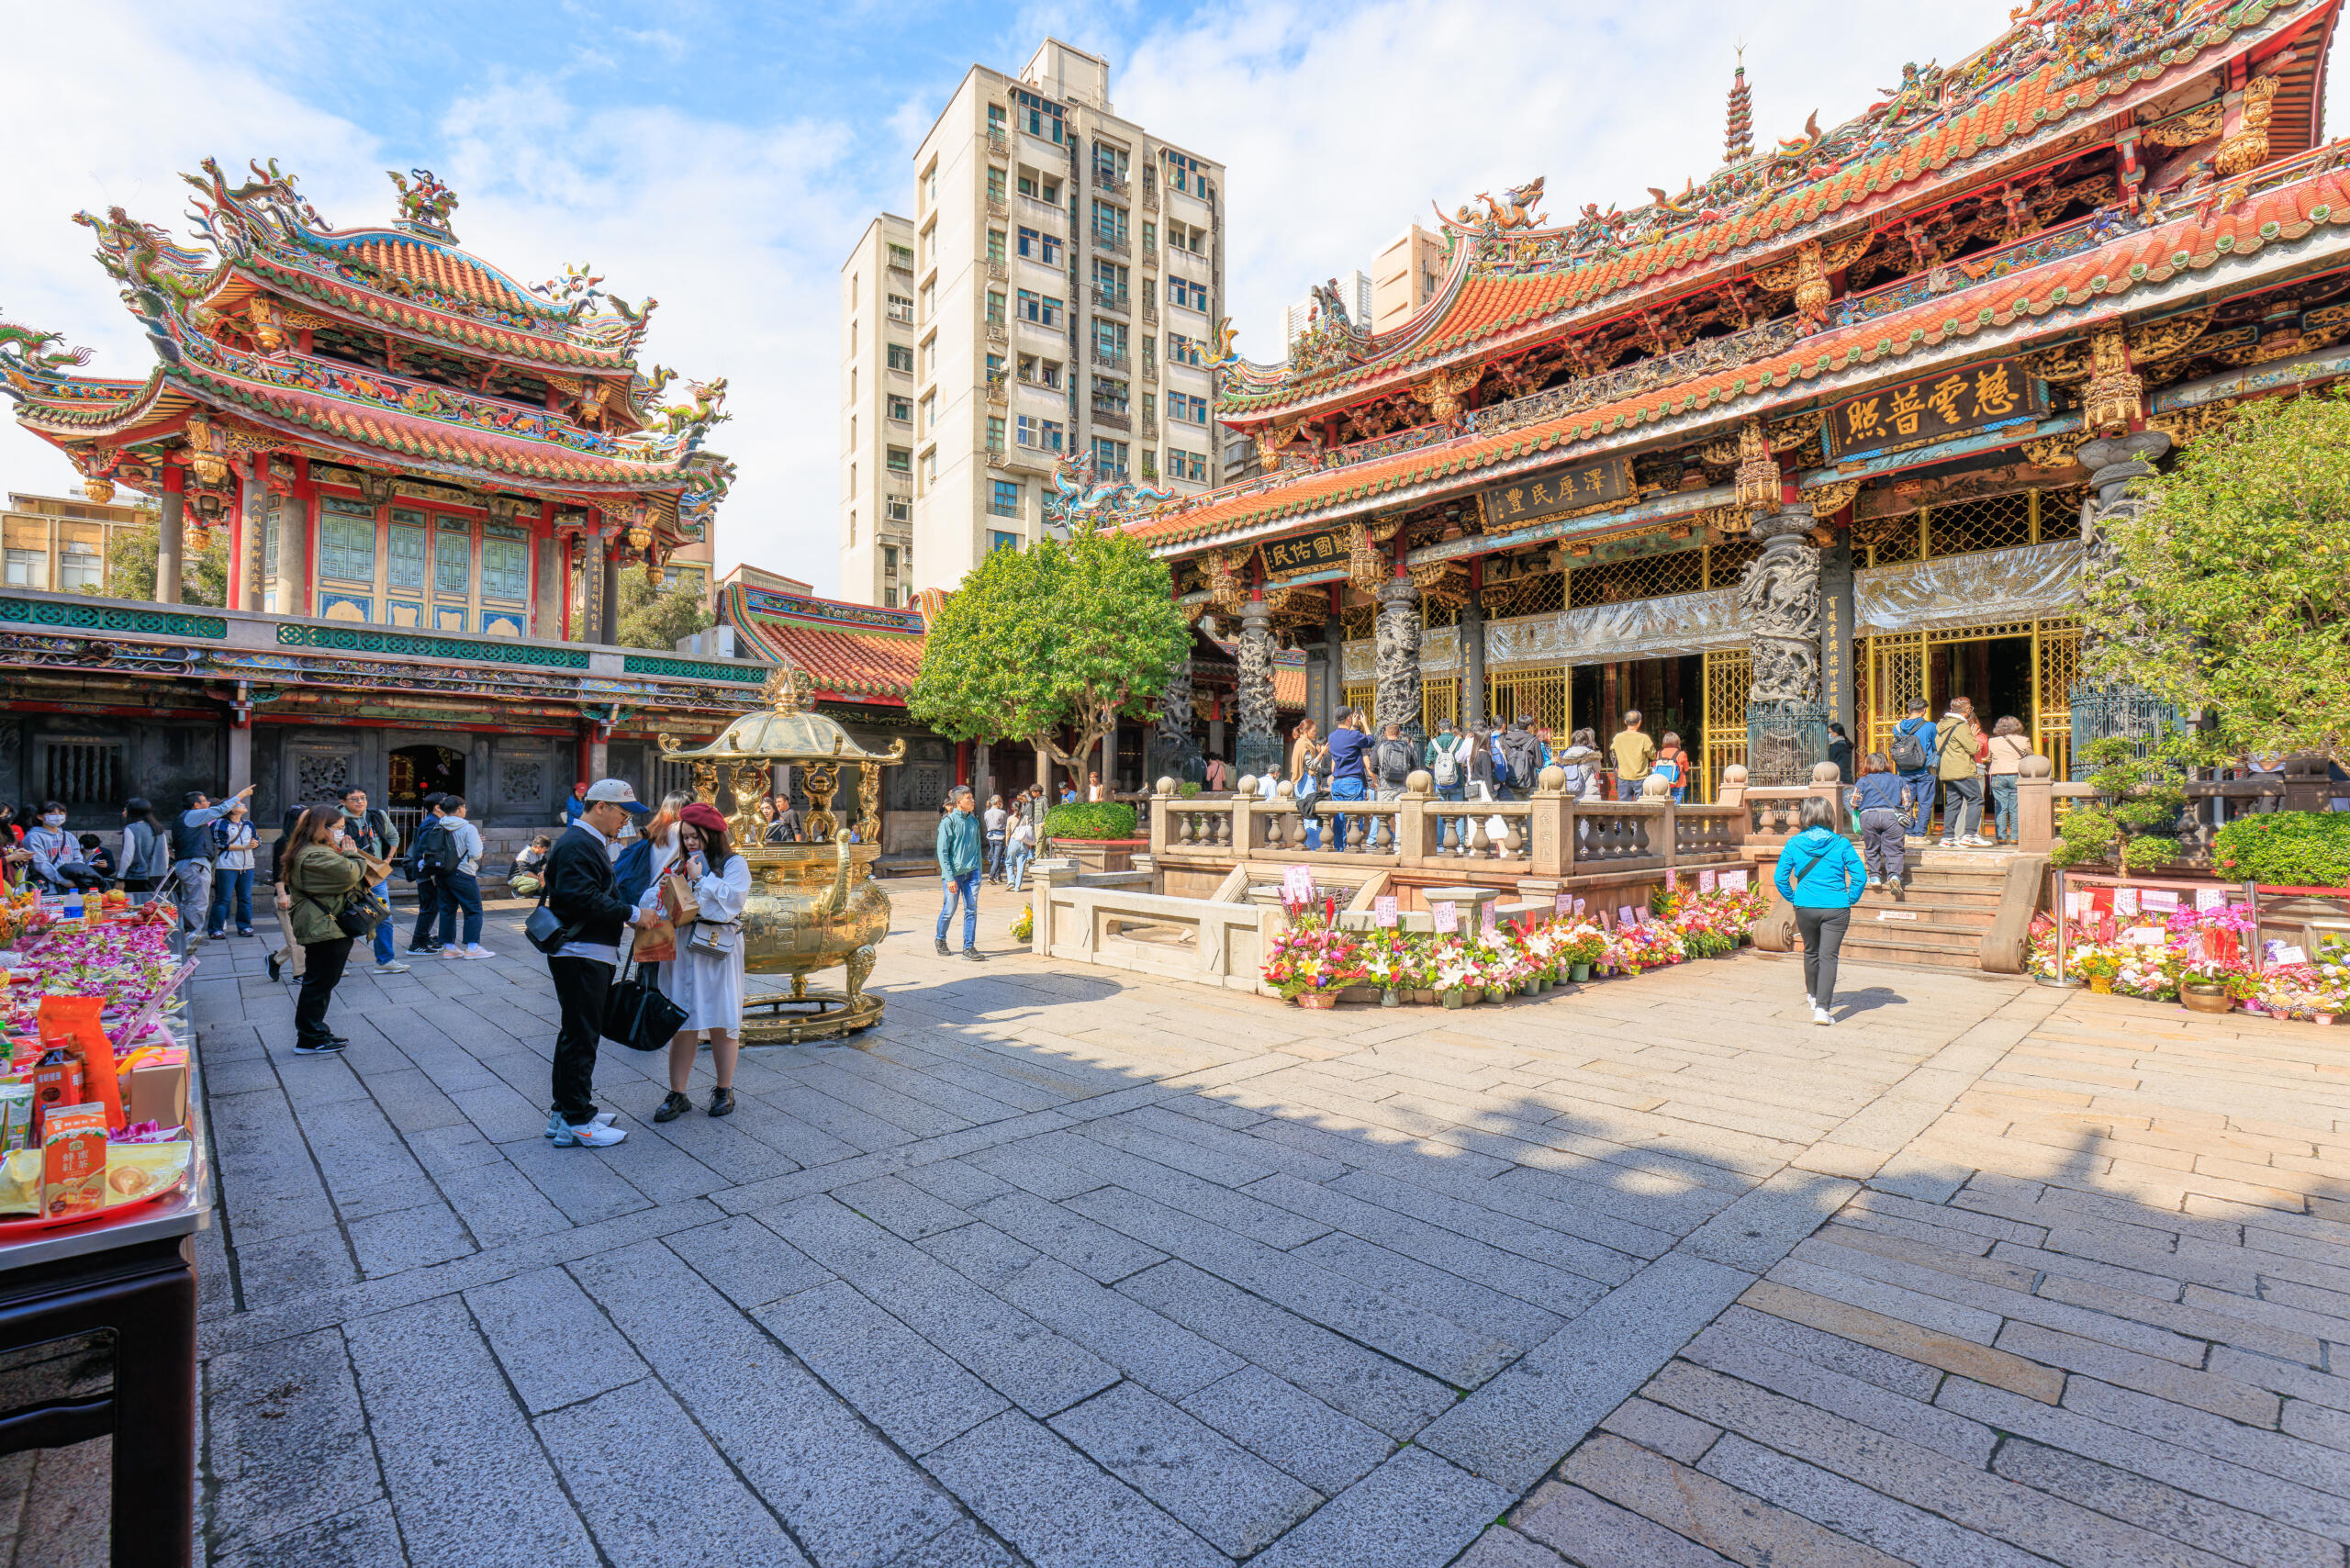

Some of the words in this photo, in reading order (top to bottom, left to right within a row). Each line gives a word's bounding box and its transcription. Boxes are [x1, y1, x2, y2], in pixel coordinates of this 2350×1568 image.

[1845, 364, 2020, 445] 慈雲普照
[1505, 467, 1606, 514] 澤厚民豐
